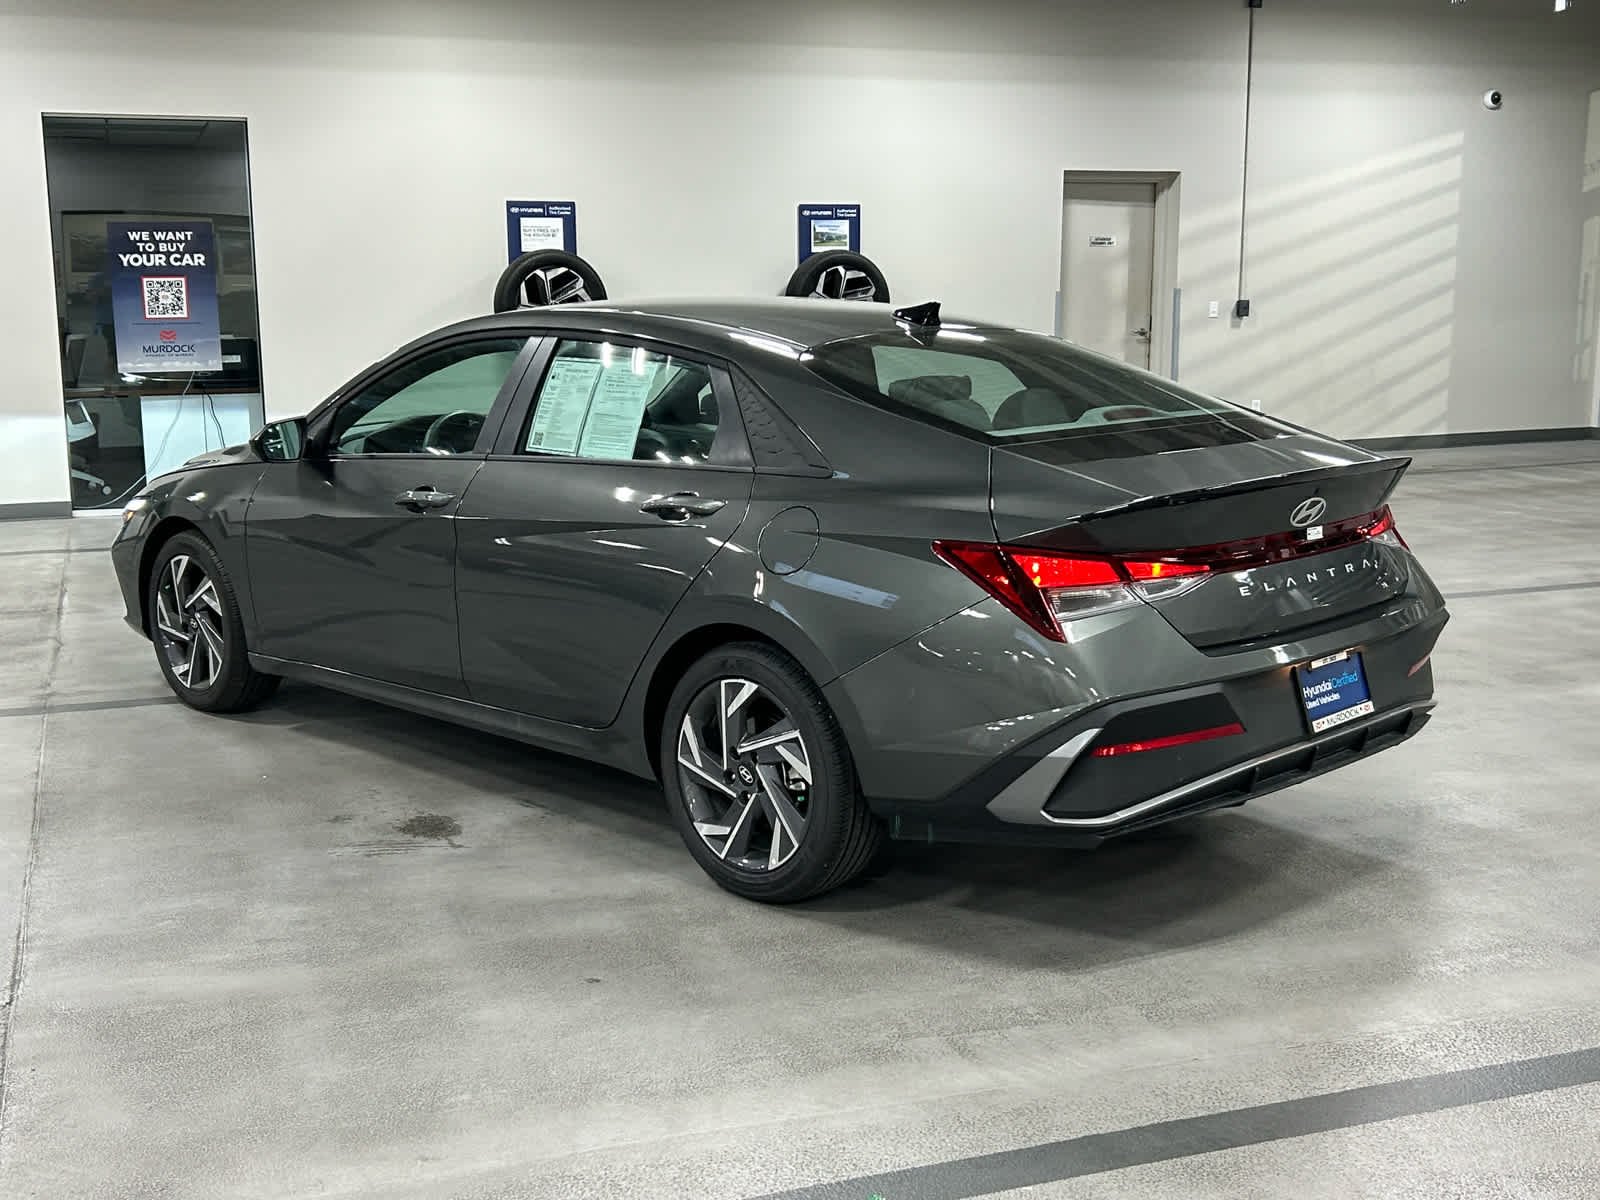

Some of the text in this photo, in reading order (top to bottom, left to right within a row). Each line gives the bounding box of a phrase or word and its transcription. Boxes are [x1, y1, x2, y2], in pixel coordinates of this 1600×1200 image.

[127, 231, 193, 241] WE WANT
[136, 242, 186, 252] TO BUY
[118, 253, 206, 267] YOUR CAR
[142, 344, 196, 353] MURDOCK
[1238, 559, 1371, 597] ELANTRA
[1302, 680, 1332, 698] Hyundai
[1306, 692, 1341, 710] Used Vehicles
